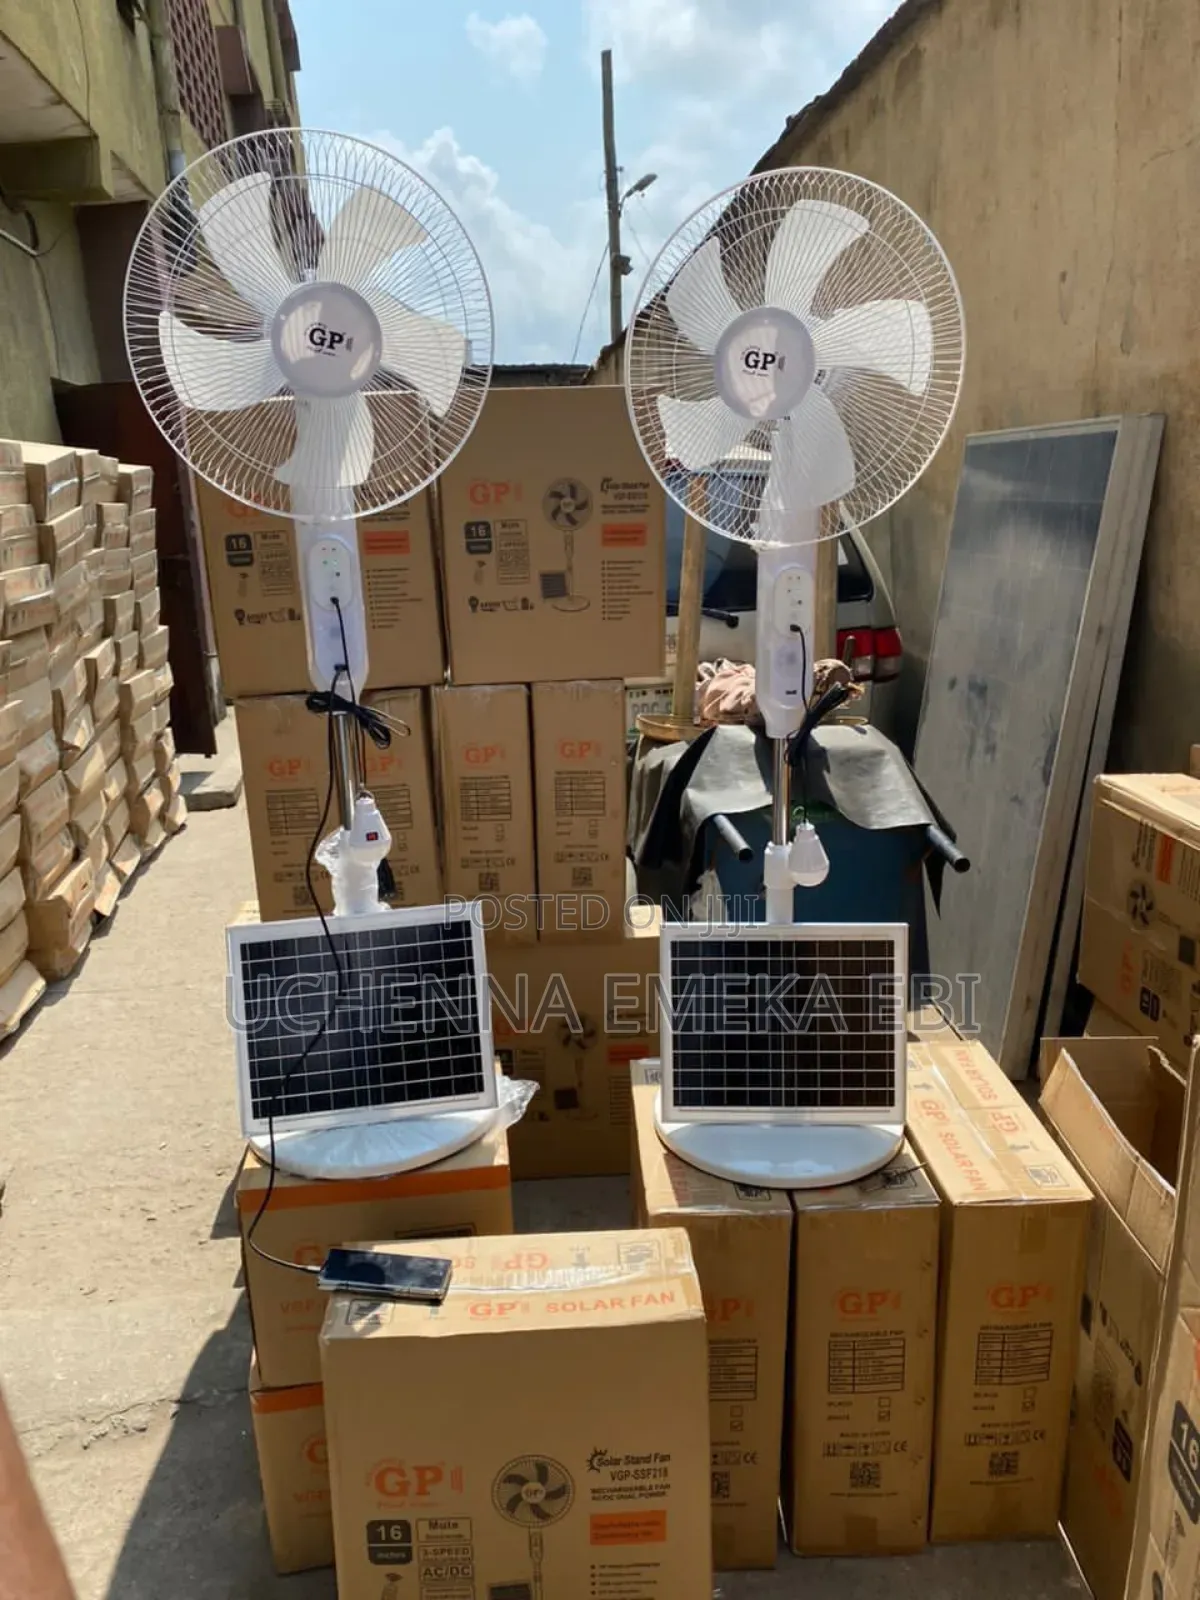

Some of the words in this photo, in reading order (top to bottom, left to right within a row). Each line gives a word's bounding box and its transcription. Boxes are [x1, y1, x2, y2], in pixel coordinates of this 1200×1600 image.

[309, 327, 345, 350] GP
[744, 350, 776, 371] GP
[468, 481, 511, 506] GP
[939, 1131, 974, 1168] SOLAR
[469, 1301, 518, 1317] GP
[546, 1299, 625, 1314] SOLAR
[630, 1291, 676, 1308] FAN
[838, 1291, 888, 1315] GP
[375, 1465, 444, 1497] GP
[376, 1525, 403, 1541] 16
[423, 1566, 471, 1579] AC/DC
